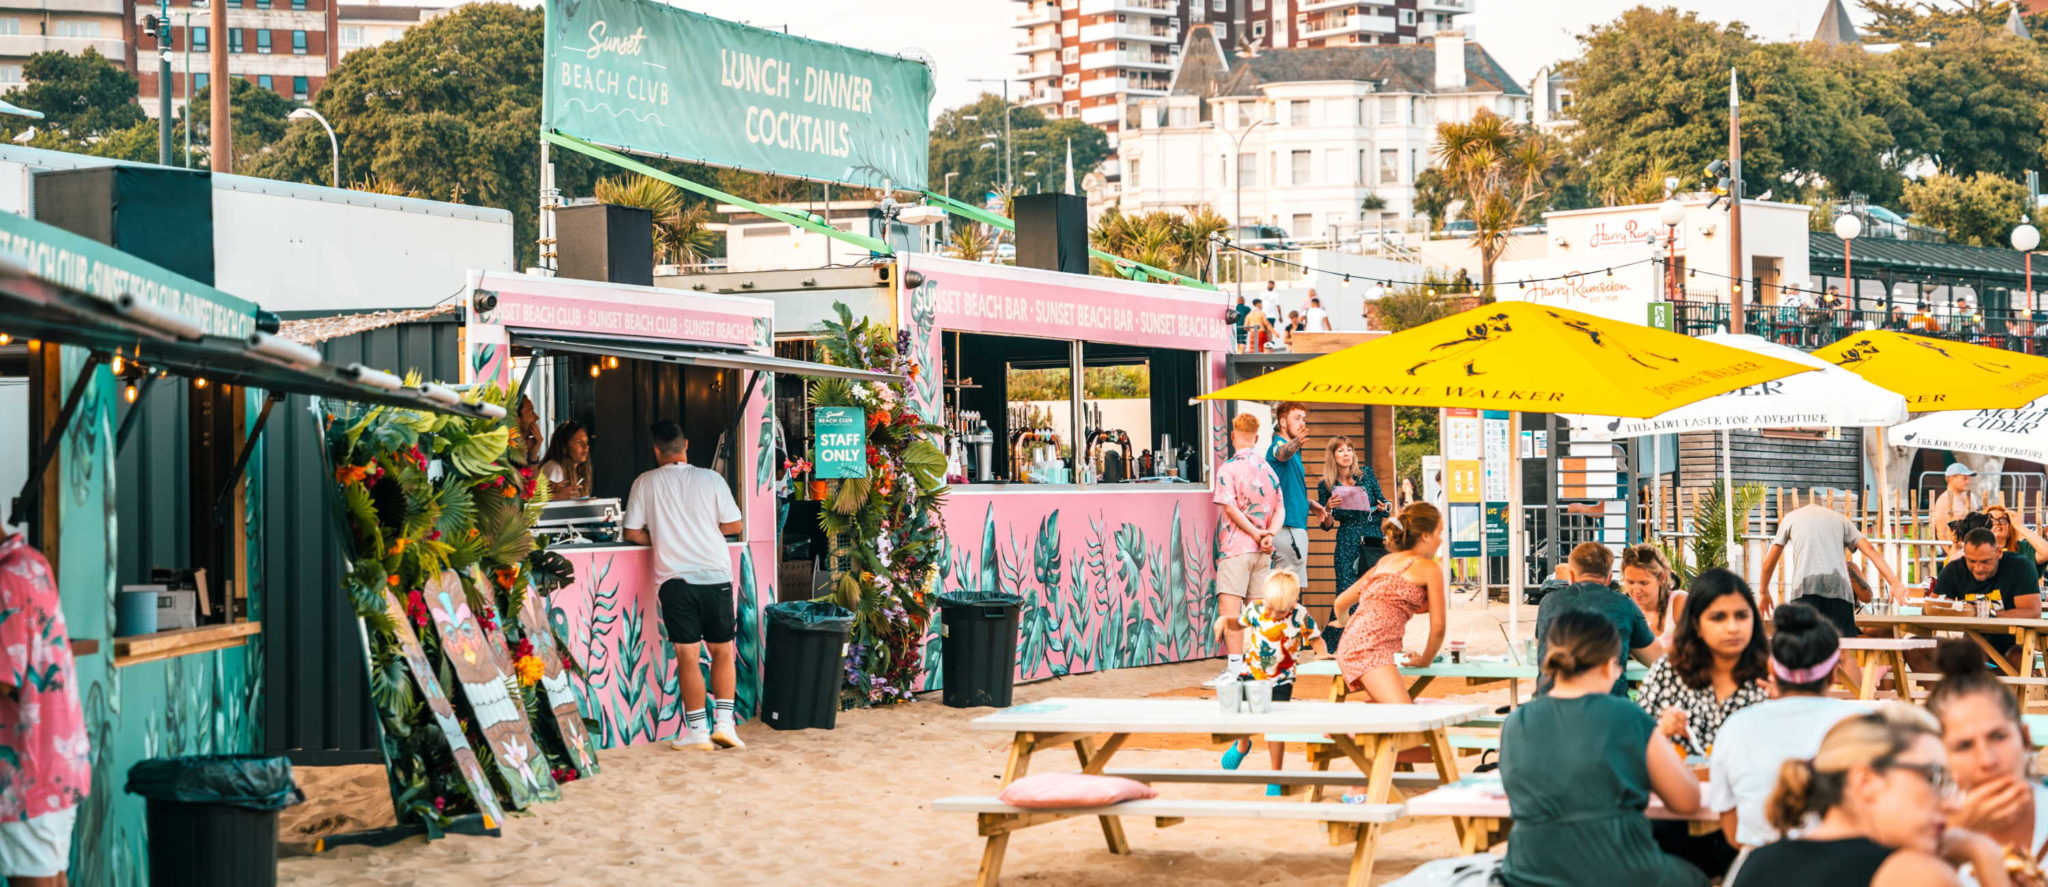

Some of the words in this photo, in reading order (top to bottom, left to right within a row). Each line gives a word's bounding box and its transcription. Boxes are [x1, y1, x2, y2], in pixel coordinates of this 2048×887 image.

[586, 20, 648, 60] Sunset
[562, 62, 619, 96] BEACH
[627, 75, 669, 105] CLUB
[721, 48, 791, 98] LUNCH
[803, 66, 873, 114] DINNER
[745, 105, 850, 158] COCKTAILS
[1590, 222, 1627, 248] Harry
[1523, 274, 1570, 304] Harry
[523, 303, 554, 323] BEACH
[557, 306, 581, 326] CLUB
[588, 309, 622, 330] SUNSET
[624, 312, 654, 332] BEACH
[656, 315, 678, 335] CLUB
[684, 318, 715, 338] SUNSET
[717, 321, 743, 340] BEACH
[915, 286, 962, 315] SUNSET
[963, 292, 1003, 319] BEACH
[1005, 297, 1028, 322] BAR
[1035, 300, 1074, 326] SUNSET
[1077, 305, 1112, 329] BEACH
[1113, 309, 1134, 332] BAR
[1141, 311, 1176, 335] SUNSET
[1178, 315, 1208, 337] BEACH
[1209, 318, 1227, 339] BAR
[1291, 381, 1430, 396] JOHNNIE
[1445, 385, 1566, 402] WALKER
[1626, 423, 1650, 433] THE
[1654, 419, 1679, 430] KIWI
[1684, 416, 1722, 427] TASTE
[1726, 415, 1748, 425] FOR
[1753, 413, 1828, 424] ADVENTURE
[1962, 416, 2039, 434] CIDER
[820, 433, 860, 447] STAFF
[821, 449, 860, 462] ONLY
